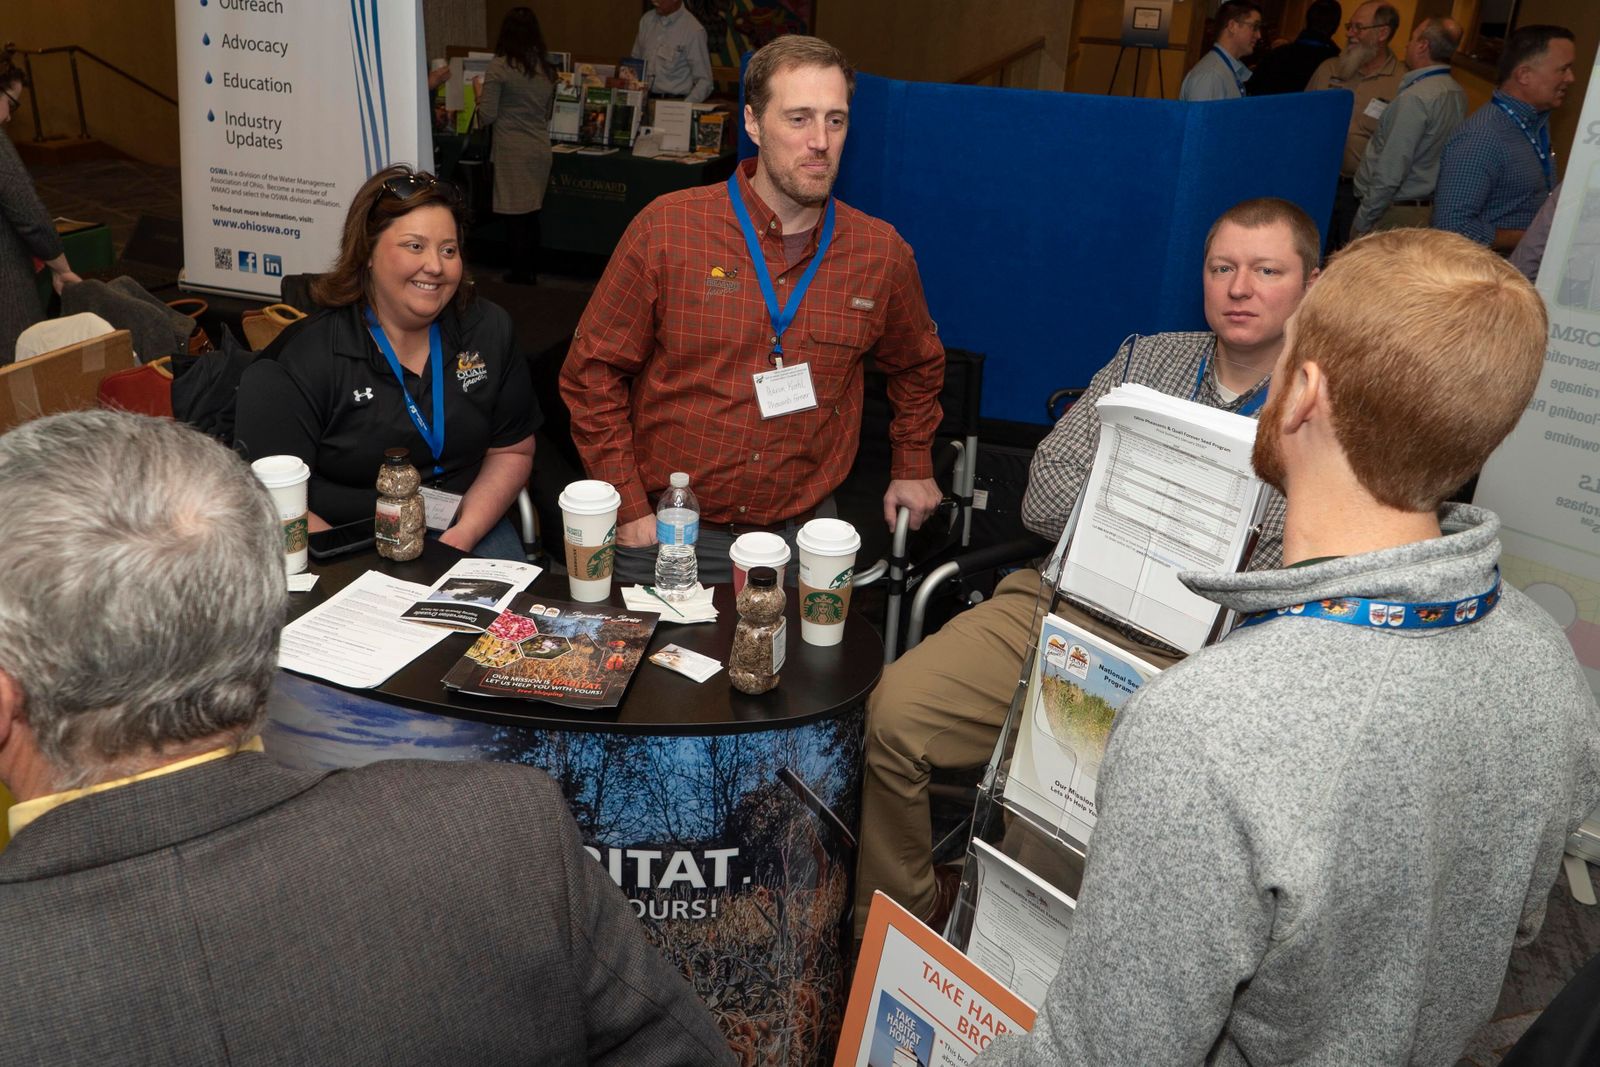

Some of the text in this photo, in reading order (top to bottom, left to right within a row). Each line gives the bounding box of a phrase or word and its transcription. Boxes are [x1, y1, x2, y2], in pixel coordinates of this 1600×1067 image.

[219, 0, 283, 14] Outreach
[222, 33, 288, 58] Advocacy
[223, 72, 292, 94] Education
[225, 110, 282, 135] Industry
[226, 129, 283, 150] Updates
[210, 167, 228, 175] OSWA
[238, 171, 260, 179] division
[279, 175, 296, 184] Water
[297, 178, 336, 188] Management
[210, 177, 241, 186] Association
[266, 184, 290, 193] Become
[296, 188, 320, 196] member
[242, 190, 260, 198] select
[290, 195, 312, 204] division
[220, 204, 232, 213] find
[260, 210, 298, 222] information,
[299, 215, 314, 224] visit:
[212, 218, 301, 240] www.ohioswa.org
[1212, 442, 1232, 452] Program
[510, 676, 542, 684] MISSION
[1098, 664, 1140, 690] National See
[1050, 786, 1063, 796] Lets
[1074, 799, 1087, 812] Help
[1054, 780, 1094, 808] Our Mission
[583, 845, 751, 889] ITAT.
[922, 960, 1014, 1036] TAKE HAB
[886, 1012, 922, 1046] HABITAT
[896, 1007, 917, 1030] TAKE
[890, 1026, 916, 1052] HOME
[944, 1042, 957, 1058] This
